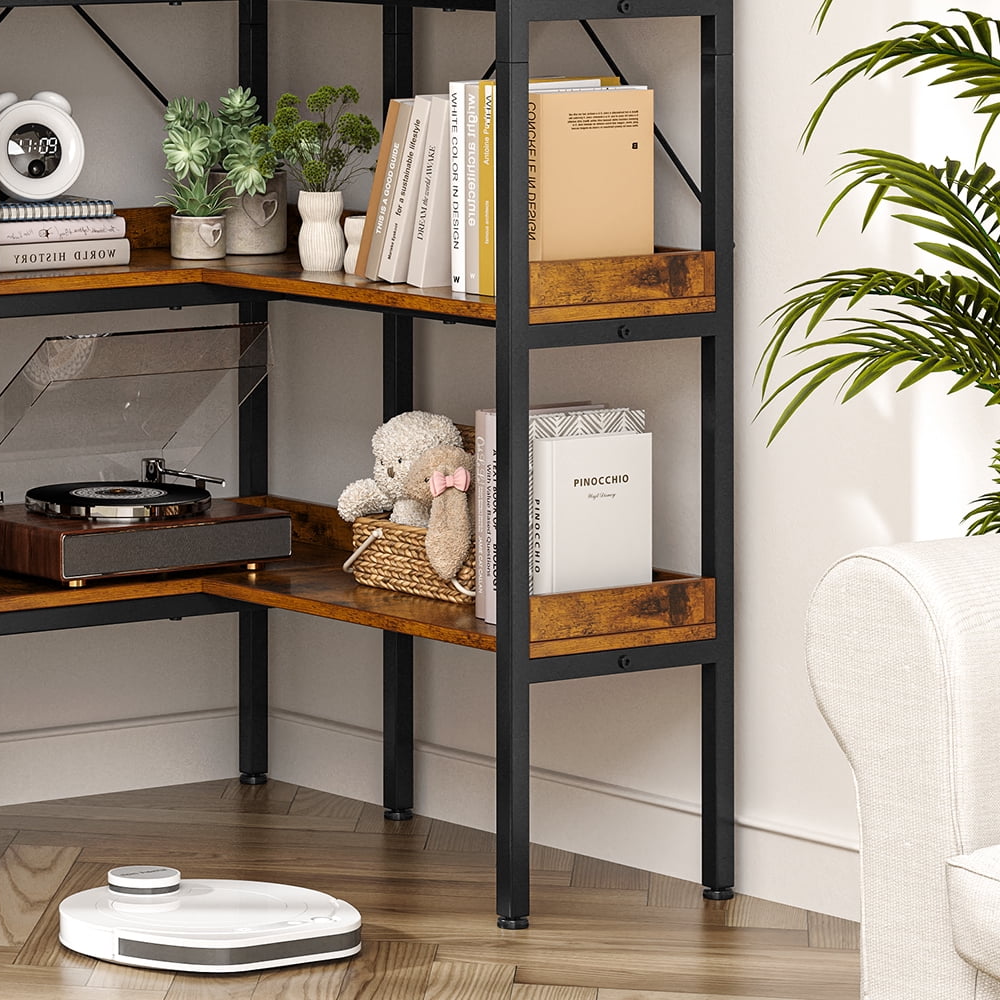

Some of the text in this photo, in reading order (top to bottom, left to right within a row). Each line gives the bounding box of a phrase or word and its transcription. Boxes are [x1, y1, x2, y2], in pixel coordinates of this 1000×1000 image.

[389, 143, 401, 169] GUIDE
[395, 205, 404, 217] for
[400, 151, 415, 196] sustainable
[409, 119, 421, 149] lifestyle
[383, 171, 396, 197] GOOD
[449, 92, 460, 250] WHITE COLOR IN DESIGN
[417, 207, 428, 241] DREAM
[427, 145, 436, 177] AWAKE
[379, 207, 388, 216] IS
[375, 216, 386, 235] THIS
[453, 275, 460, 284] W
[573, 474, 630, 488] PINOCCHIO
